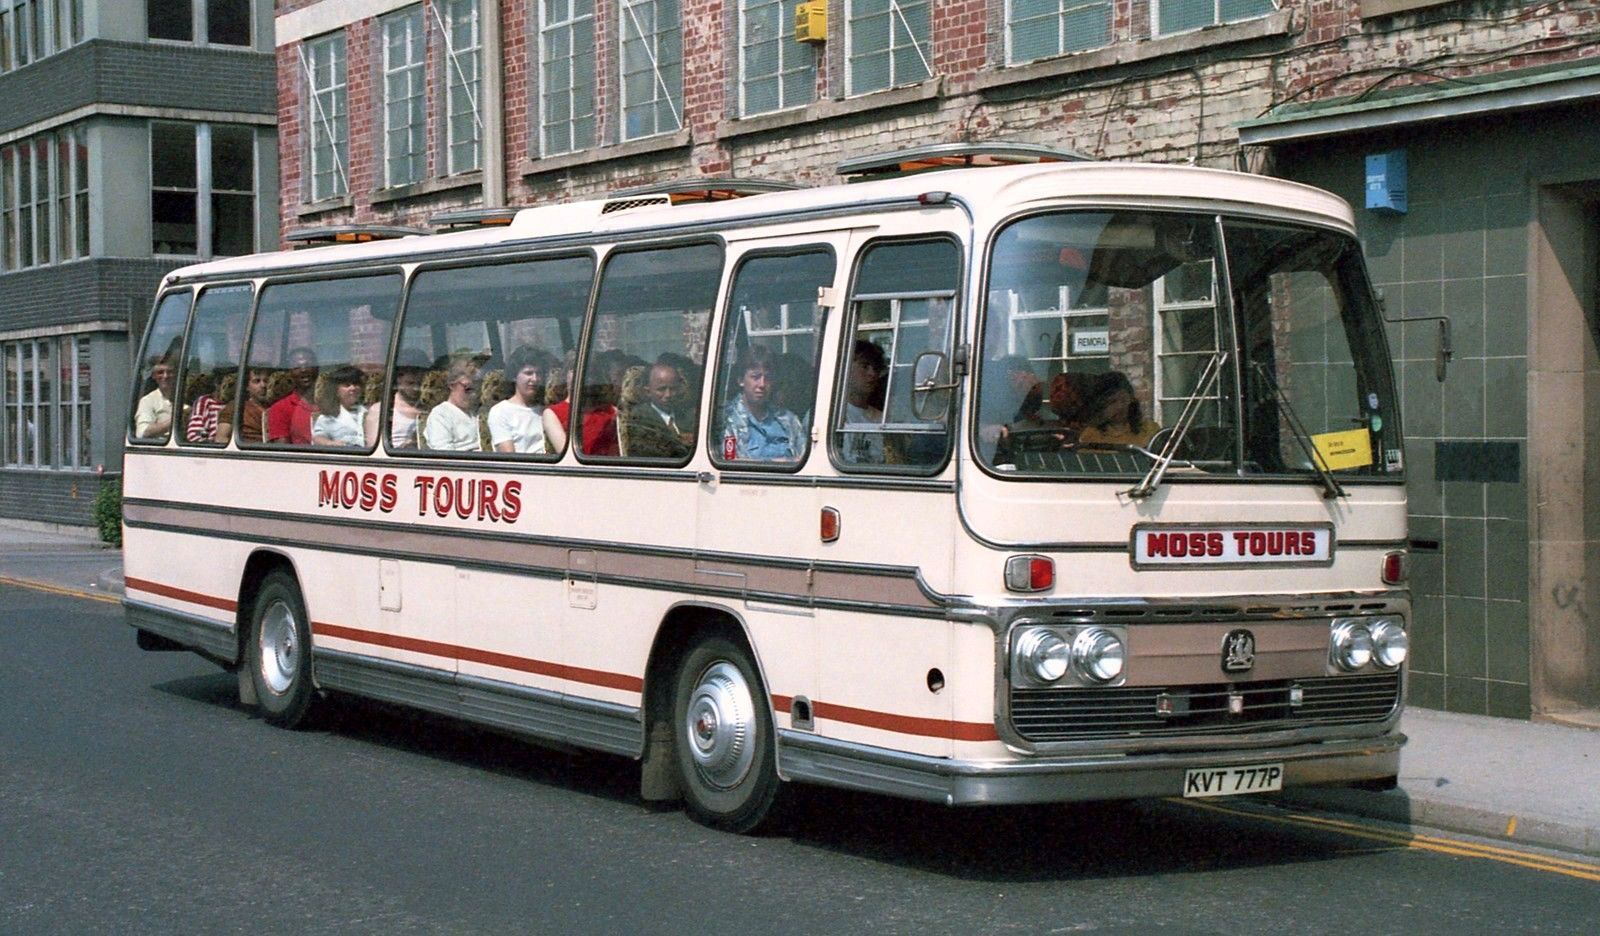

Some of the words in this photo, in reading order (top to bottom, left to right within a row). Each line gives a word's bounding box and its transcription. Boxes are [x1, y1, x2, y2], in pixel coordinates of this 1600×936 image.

[319, 470, 398, 513] MOSS
[414, 476, 522, 524] TOURS
[1147, 533, 1224, 558] MOSS
[1233, 531, 1316, 556] TOURS
[1187, 771, 1227, 793] KVT
[1234, 767, 1280, 790] 777P
